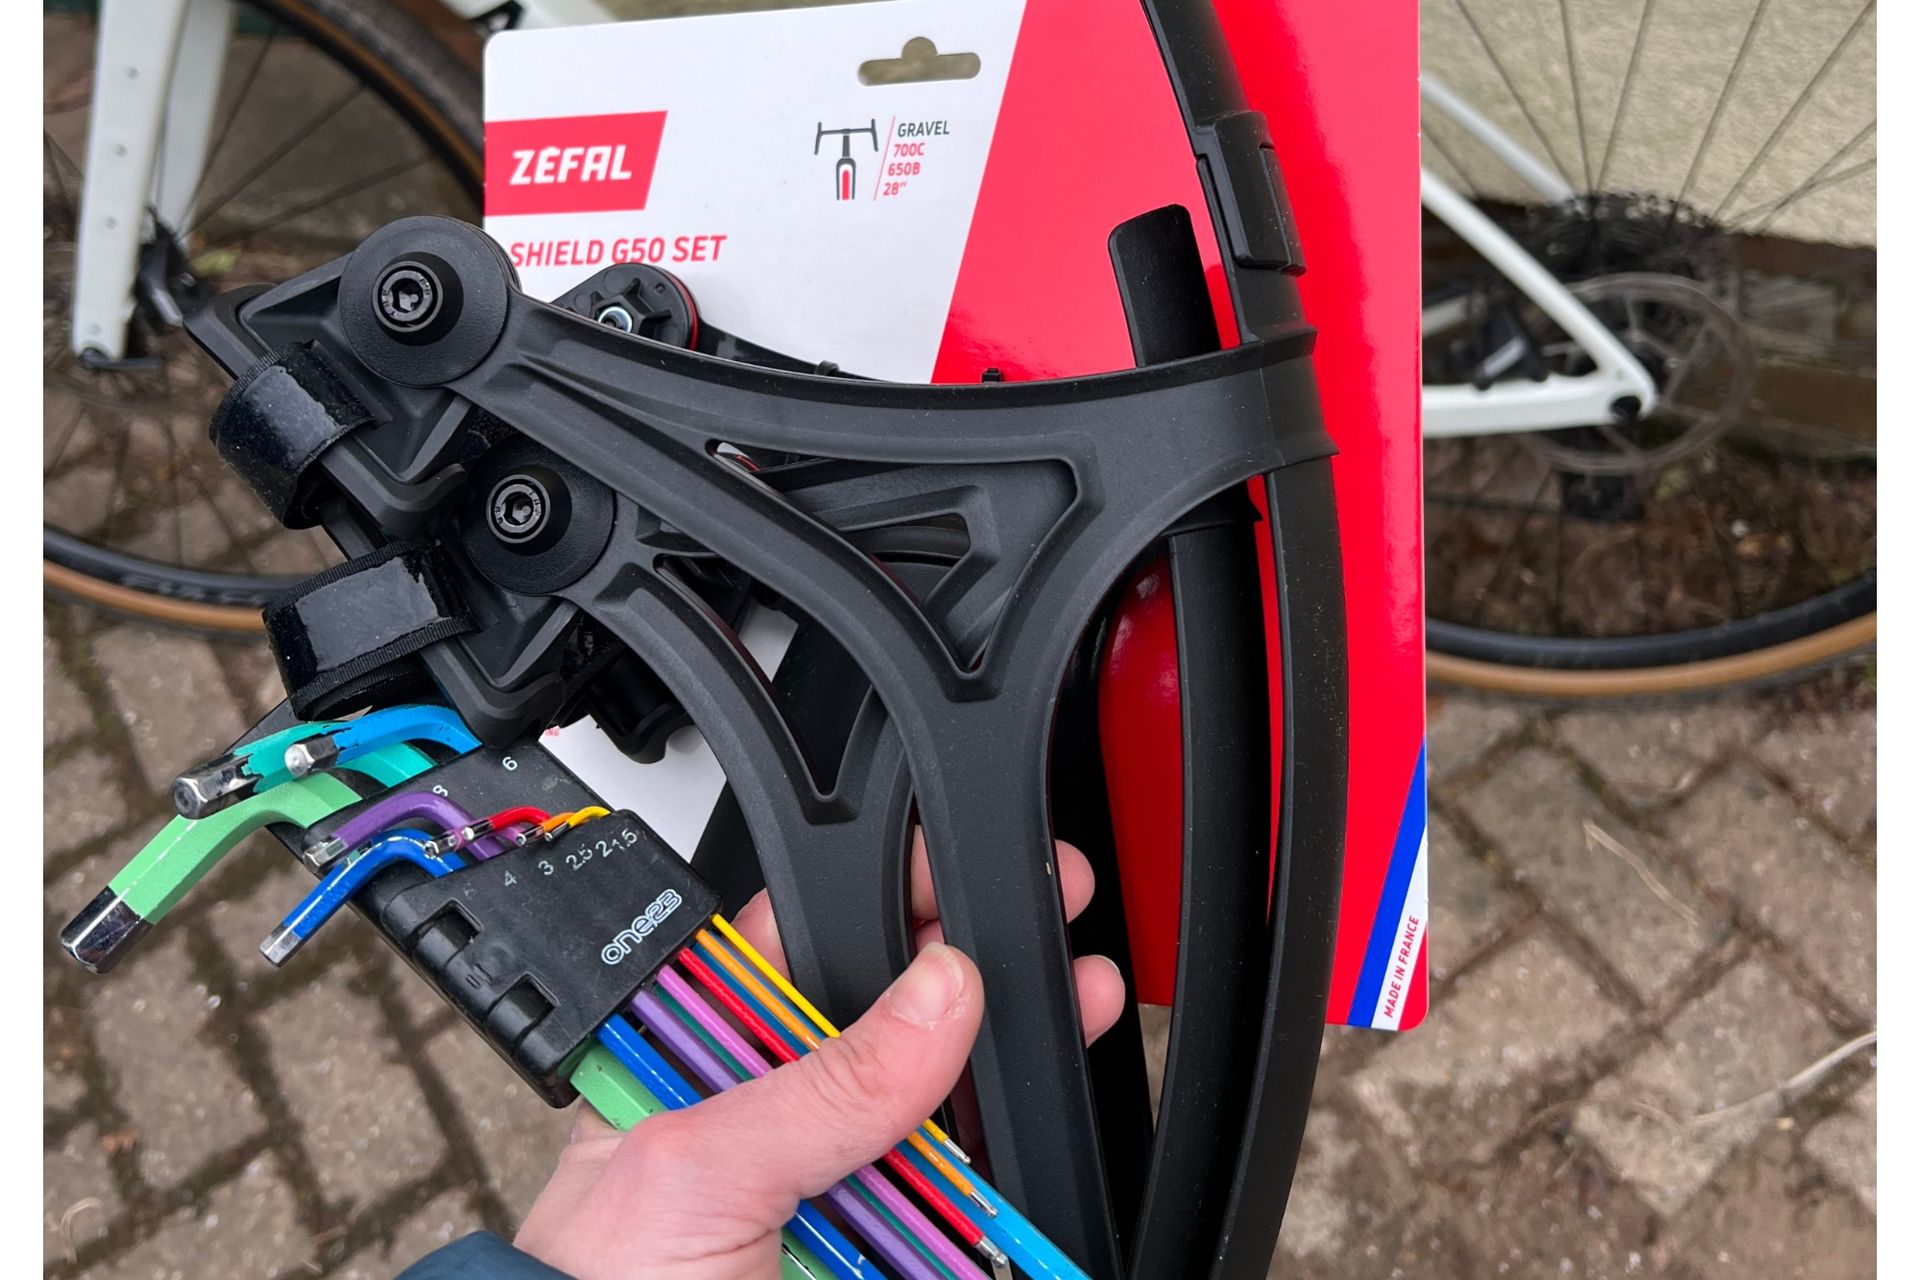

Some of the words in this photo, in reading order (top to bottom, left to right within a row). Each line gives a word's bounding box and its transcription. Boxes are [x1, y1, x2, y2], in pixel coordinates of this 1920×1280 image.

[897, 120, 950, 138] GRAVEL
[893, 142, 925, 157] 700C
[887, 161, 920, 176] 650B
[509, 239, 605, 267] SHIELD
[611, 236, 665, 264] G50
[672, 235, 728, 263] SET
[502, 756, 518, 771] 6
[504, 870, 518, 886] 4
[538, 860, 554, 876] 3
[565, 843, 593, 871] 2.5
[595, 840, 613, 858] 2
[601, 888, 683, 965] one23
[1398, 915, 1419, 965] FRANCE
[1394, 965, 1406, 980] IN
[1384, 981, 1402, 1018] MADE
